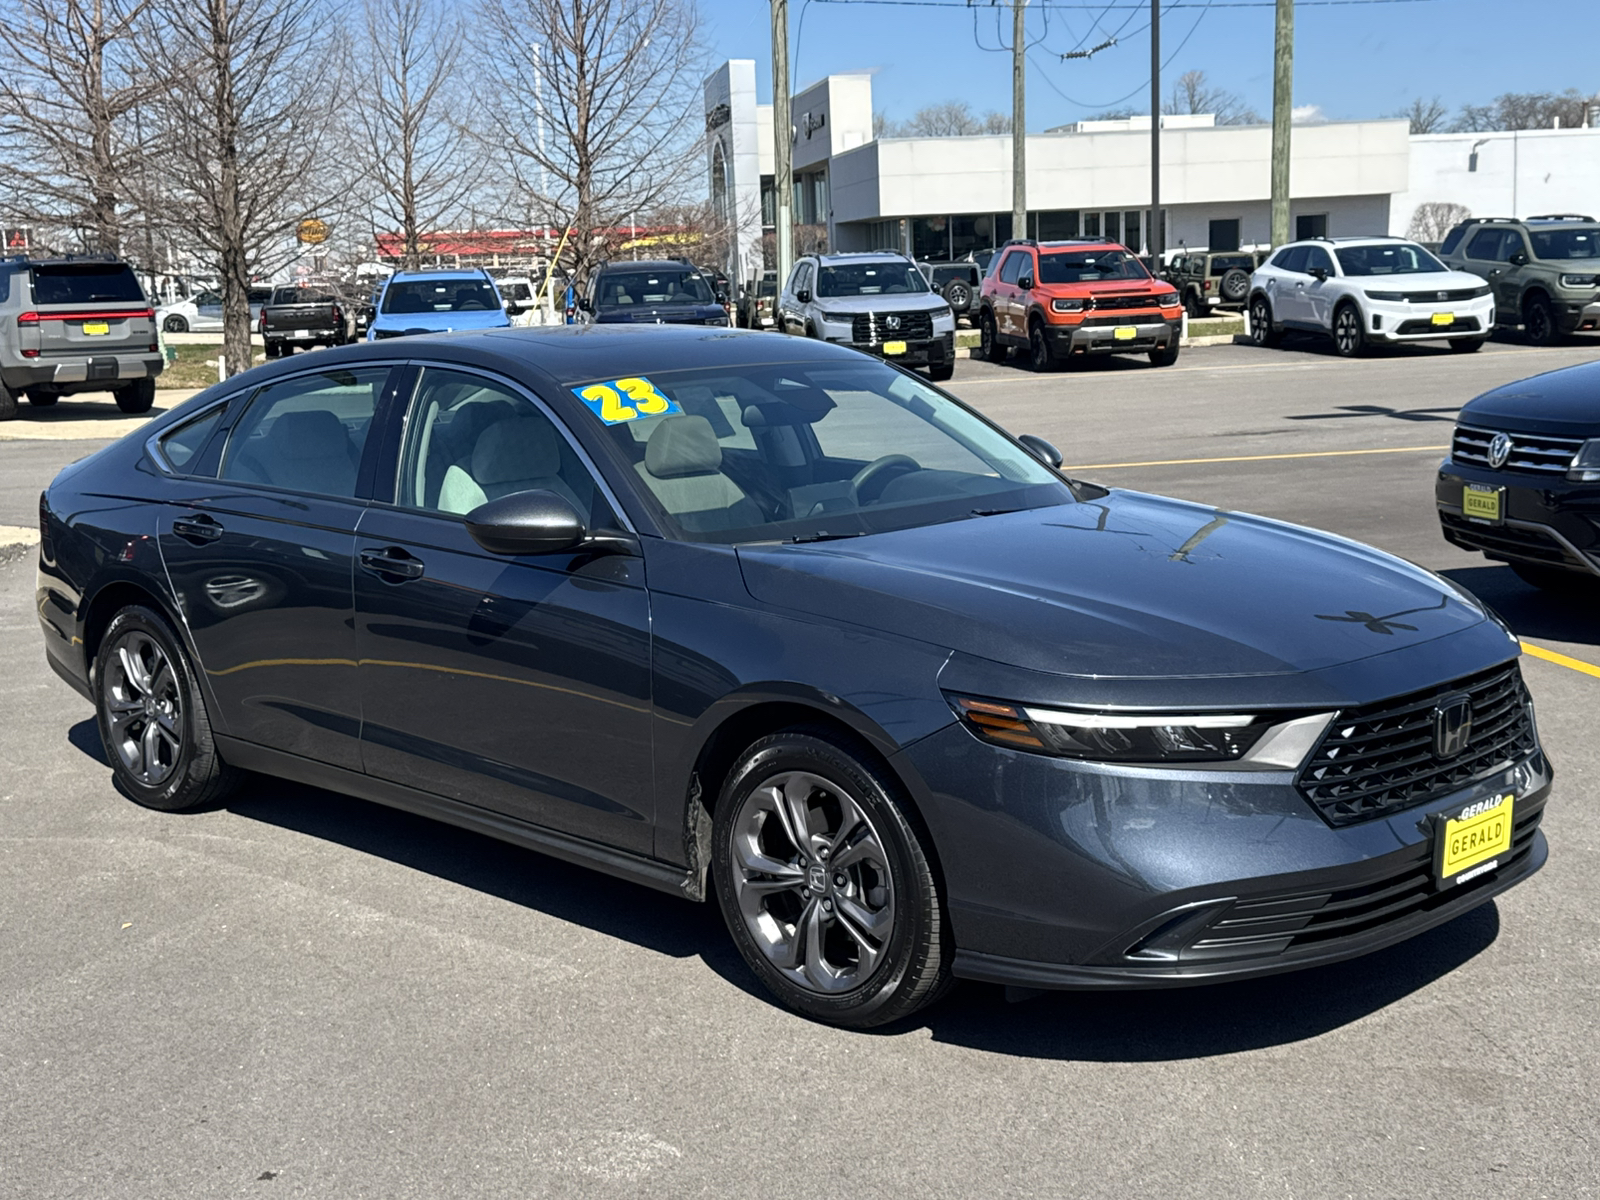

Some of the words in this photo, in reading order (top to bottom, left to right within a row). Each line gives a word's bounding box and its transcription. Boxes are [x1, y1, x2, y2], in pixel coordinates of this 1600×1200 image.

[580, 377, 669, 423] 23
[1468, 498, 1496, 511] GERALD
[1461, 794, 1503, 821] GERALD
[1452, 822, 1502, 856] GERALD
